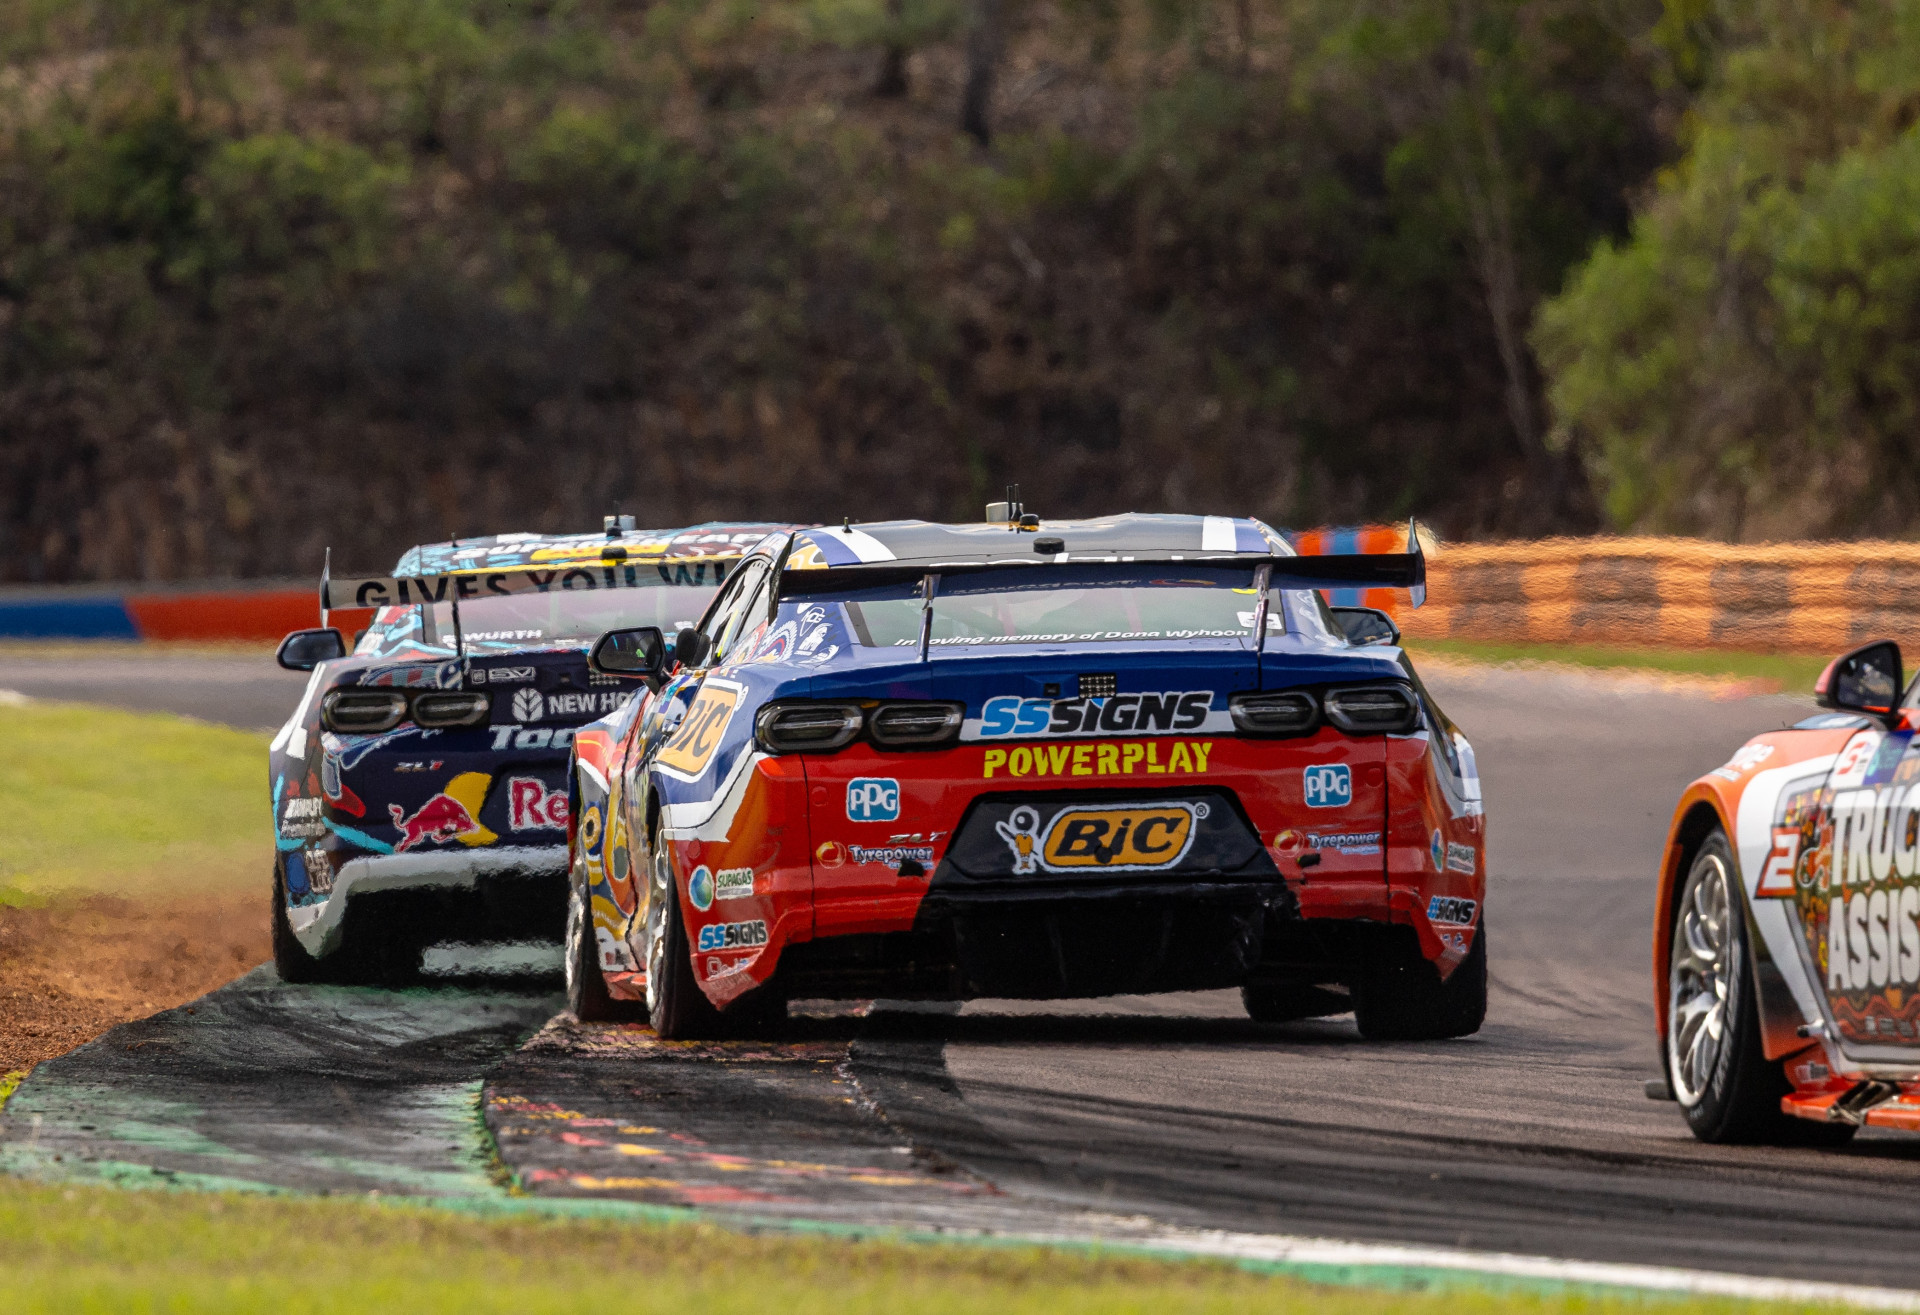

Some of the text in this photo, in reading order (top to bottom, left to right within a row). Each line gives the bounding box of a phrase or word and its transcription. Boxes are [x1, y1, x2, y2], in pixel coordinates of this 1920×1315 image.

[356, 573, 511, 607] GIVES
[895, 629, 1248, 646] In oving memory of Dana Wyhoon
[549, 693, 597, 714] NEW
[983, 742, 1212, 778] POWERPLAY
[850, 783, 896, 817] PPG
[1306, 769, 1348, 802] PPG
[1307, 833, 1380, 850] Tyrepower
[1831, 783, 1920, 886] TRUC
[850, 846, 934, 864] Tyrepower
[718, 870, 752, 888] SUPAGAS
[1828, 886, 1920, 989] ASSIS
